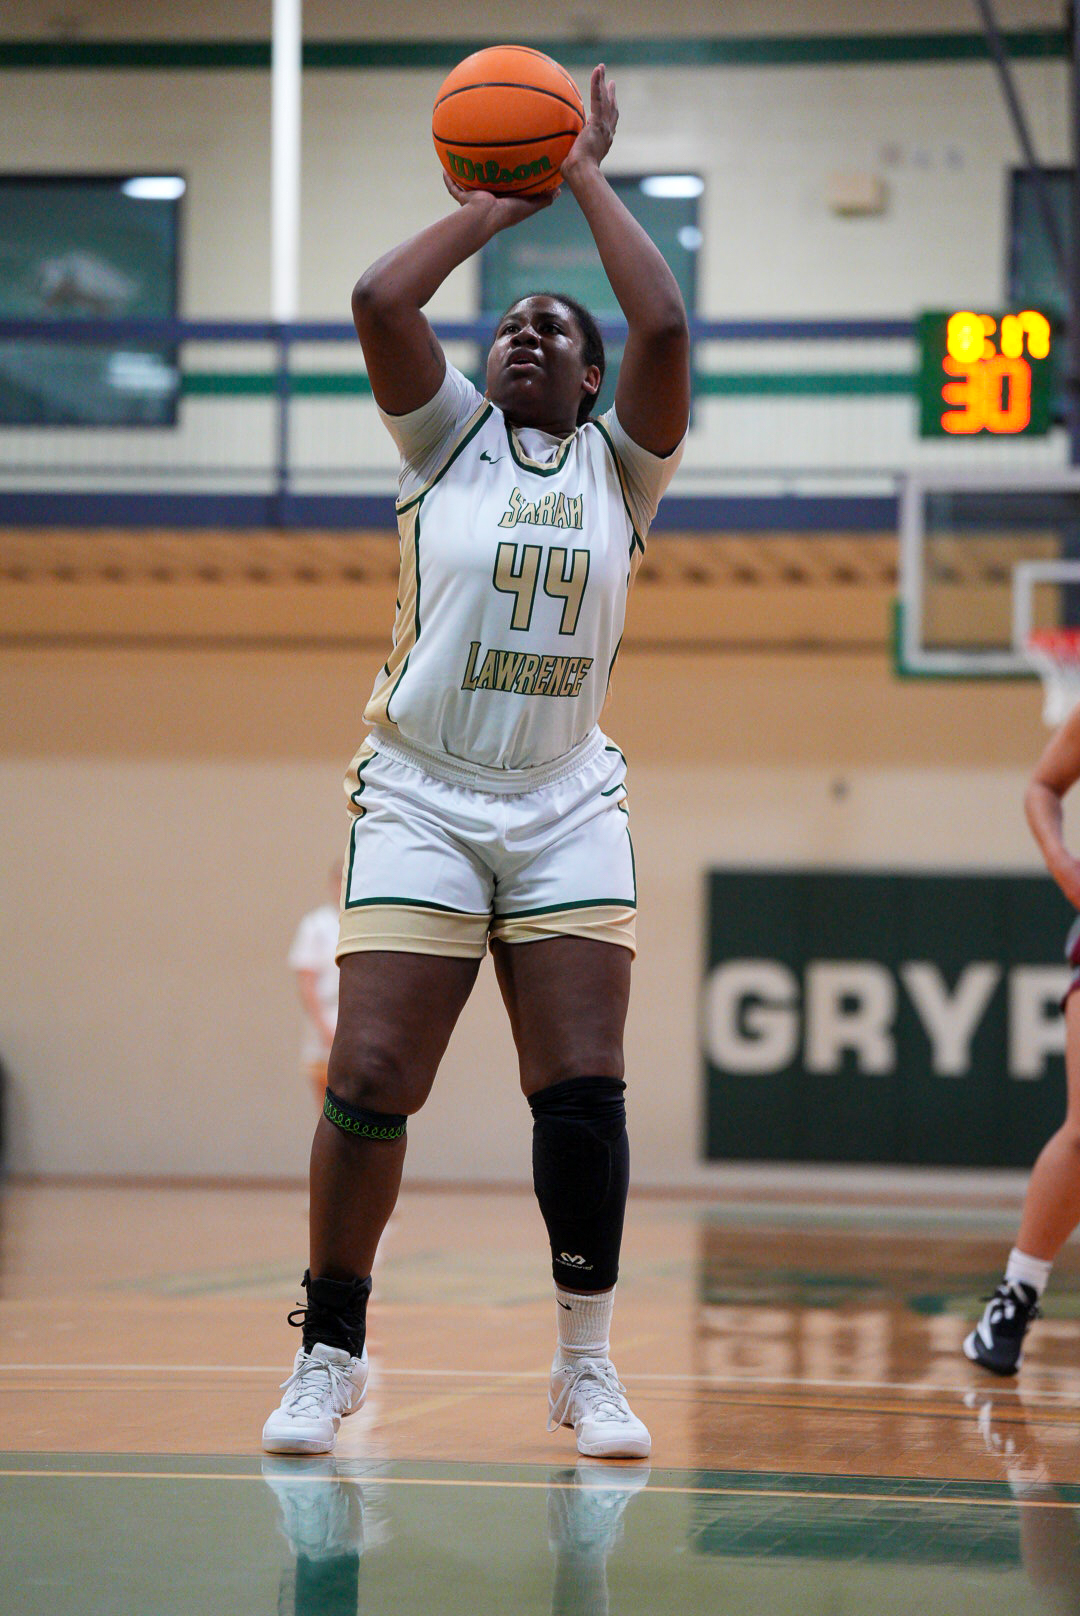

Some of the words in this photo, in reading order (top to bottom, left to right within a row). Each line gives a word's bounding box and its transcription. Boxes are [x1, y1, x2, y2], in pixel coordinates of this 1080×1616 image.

[446, 150, 552, 183] Wilson
[941, 354, 1032, 434] 30
[498, 487, 584, 530] SARAH
[492, 541, 591, 635] 44
[461, 641, 594, 697] LAWRENCE
